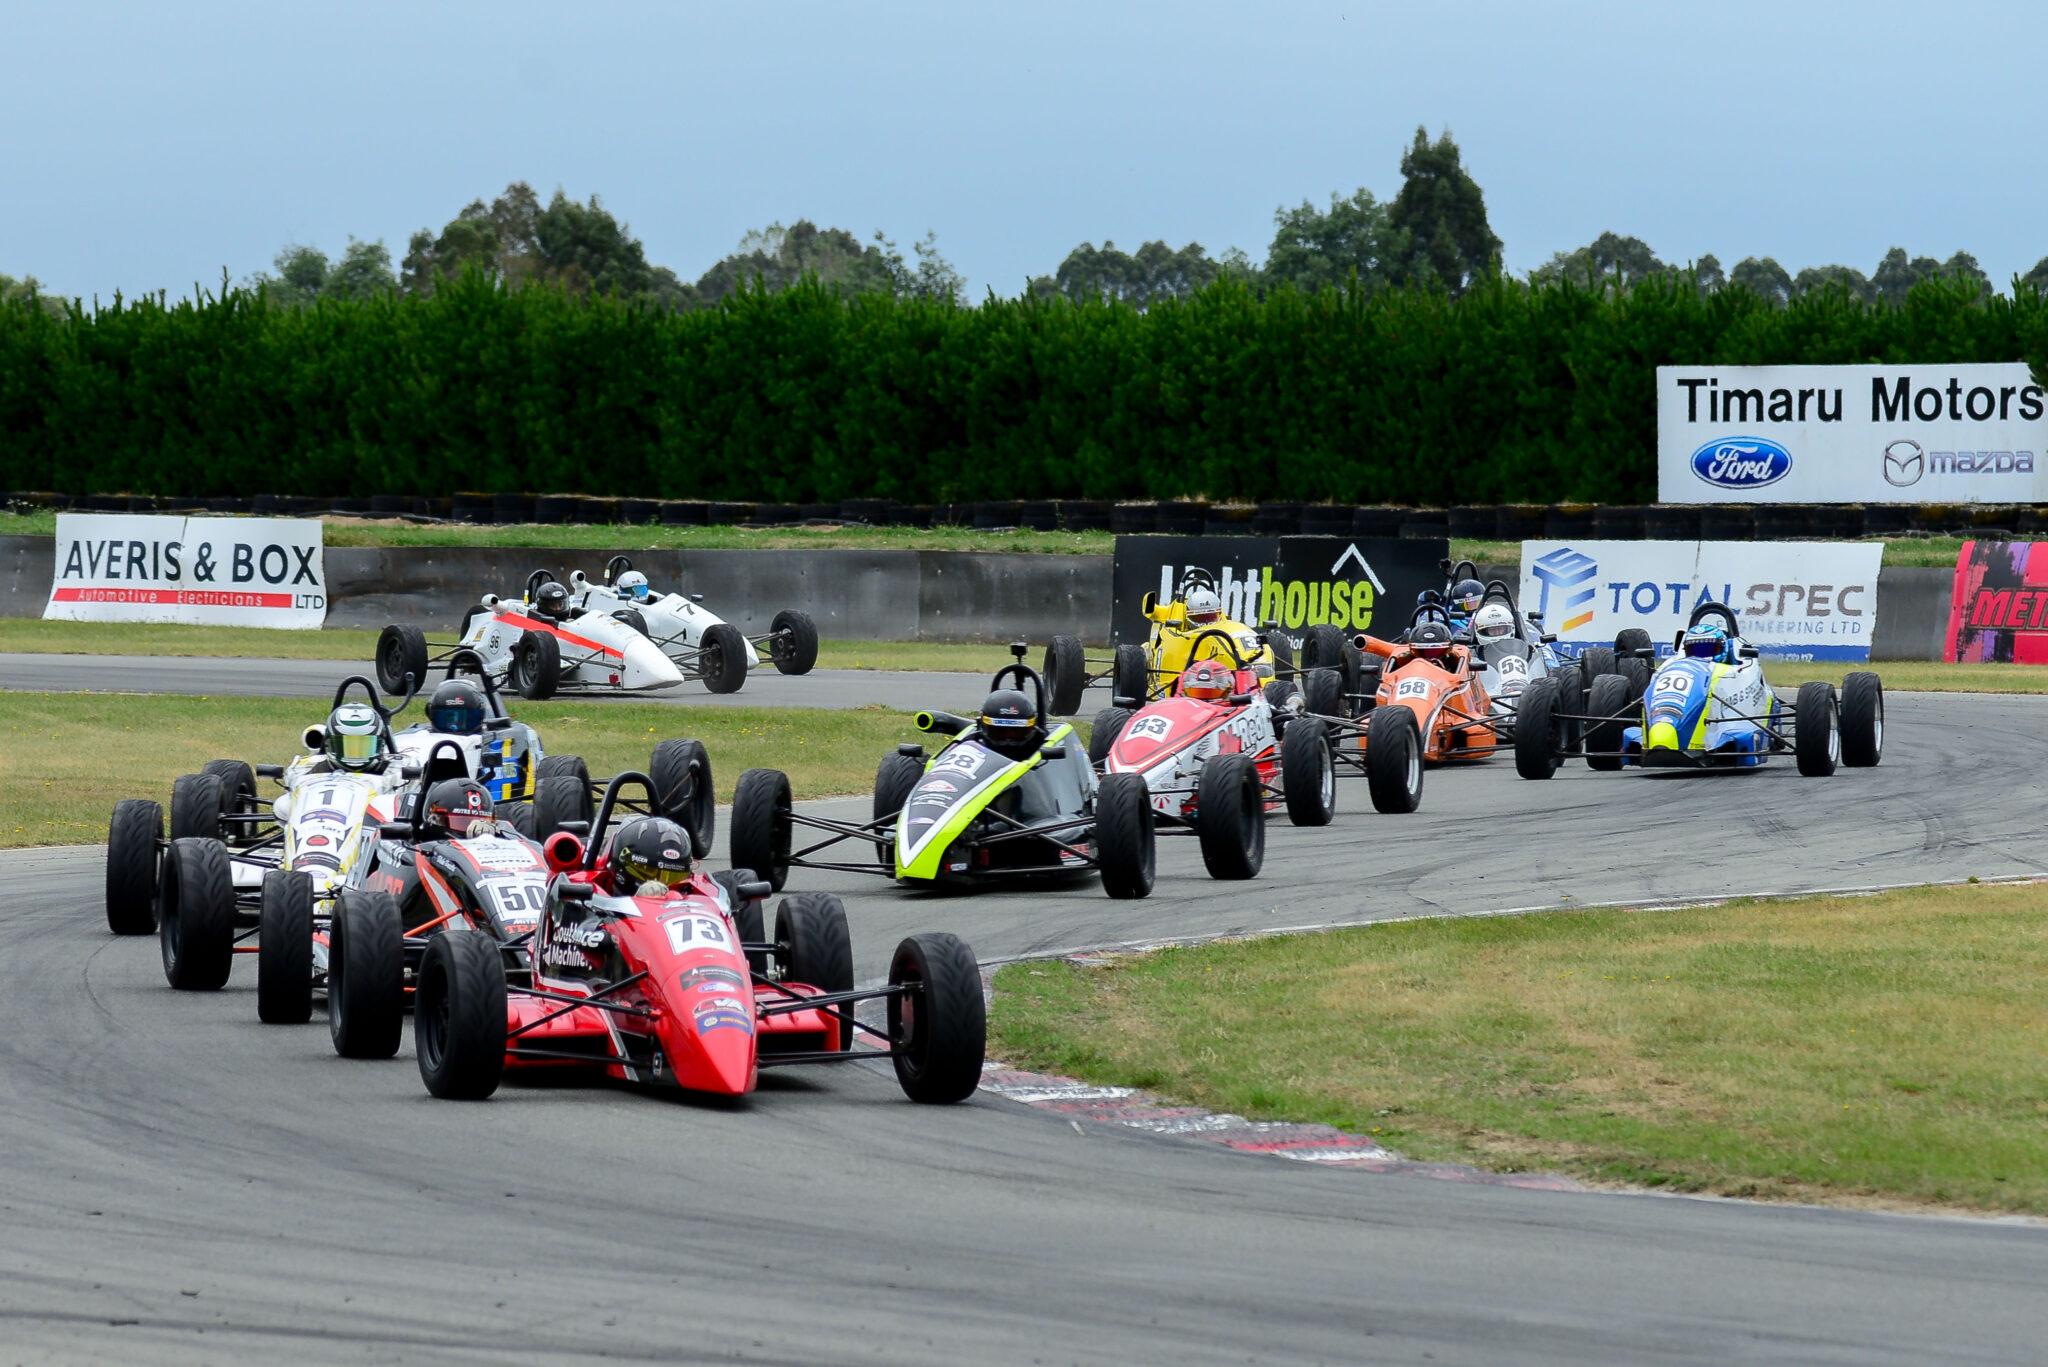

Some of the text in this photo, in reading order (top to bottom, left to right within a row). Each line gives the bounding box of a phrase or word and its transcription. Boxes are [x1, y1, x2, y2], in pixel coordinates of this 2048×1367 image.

[1677, 376, 2045, 423] Timaru Motors
[1708, 444, 1774, 481] Ford
[62, 540, 321, 586] AVERIS & BOX
[76, 588, 264, 607] Automotive Electricians
[295, 594, 325, 609] LTD
[676, 603, 695, 616] 7
[1969, 587, 2048, 629] MET
[1717, 619, 1861, 634] EGINEERING LTD
[489, 635, 500, 649] 96
[1501, 658, 1527, 675] 53
[1398, 681, 1426, 695] 58
[1656, 676, 1688, 692] 30
[943, 753, 975, 769] 28
[319, 789, 335, 805] 1
[500, 885, 546, 911] 50
[672, 919, 724, 943] 73
